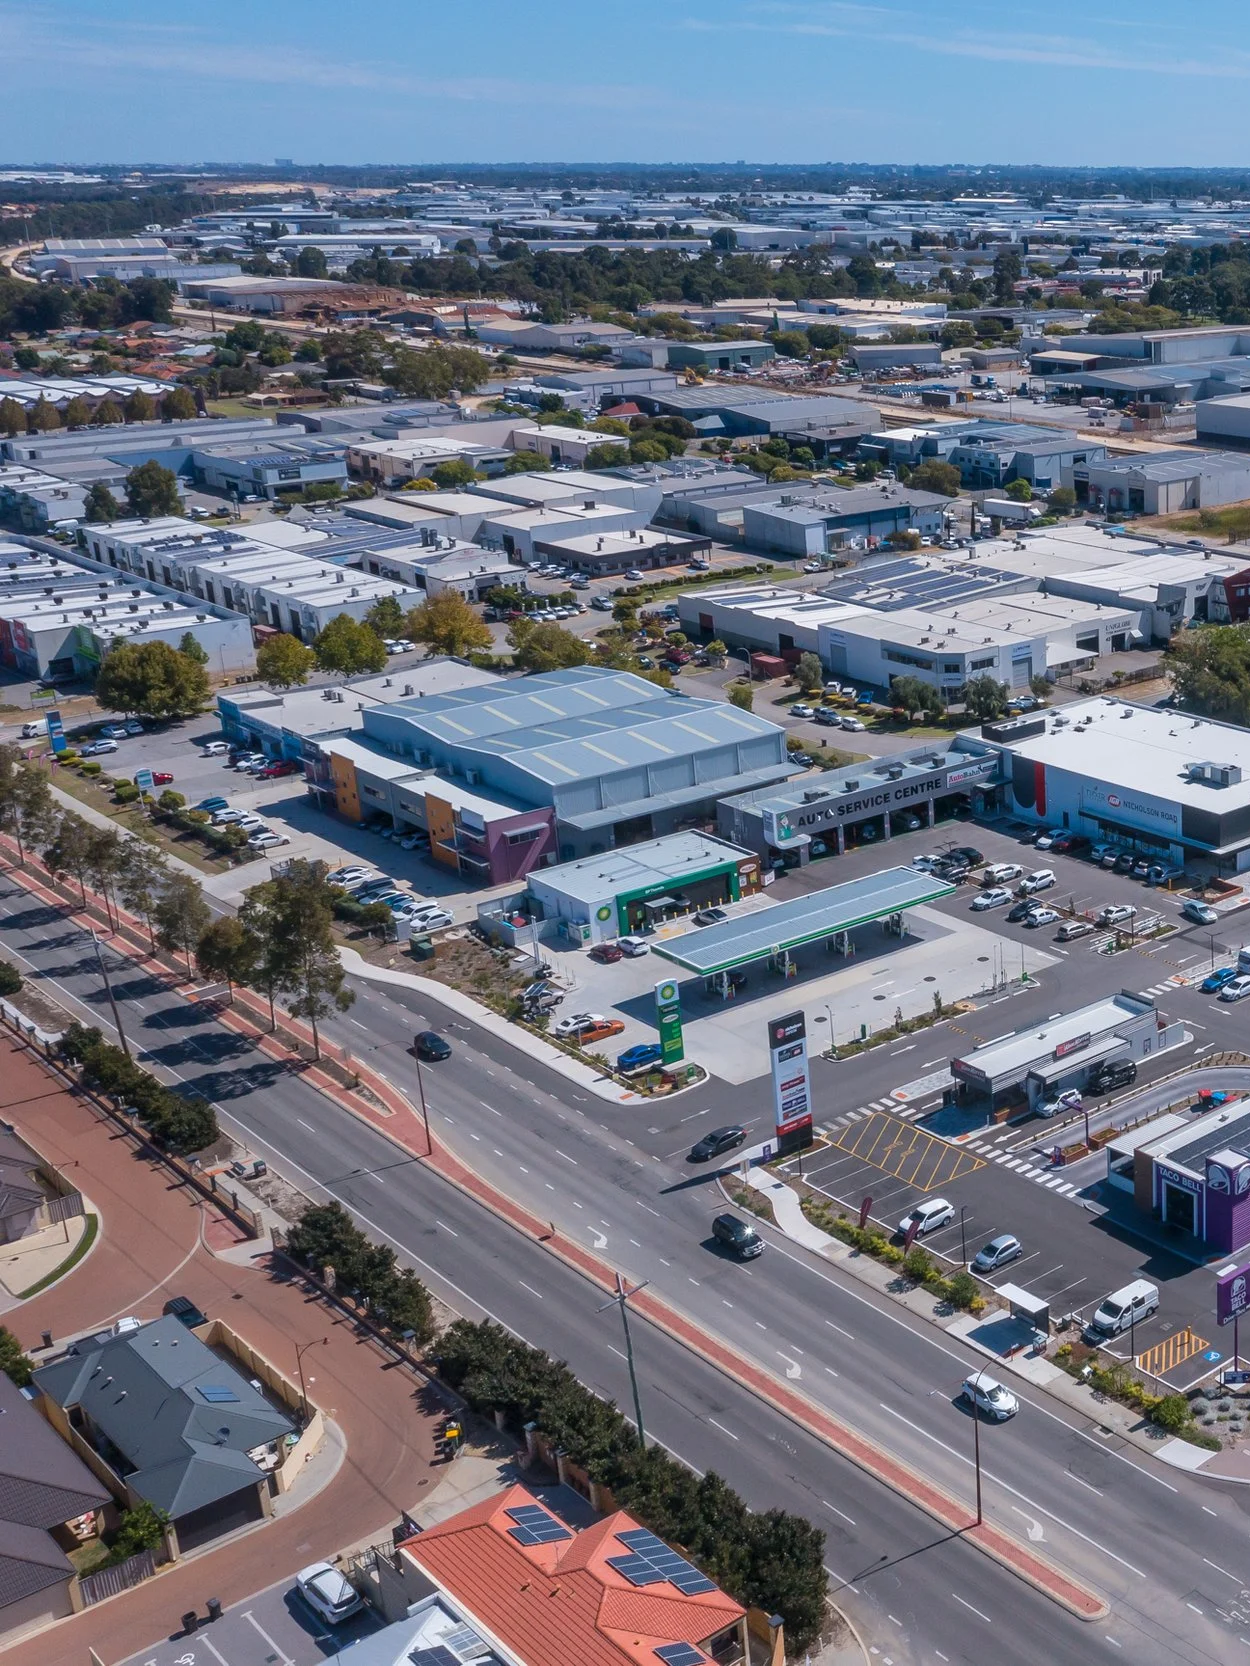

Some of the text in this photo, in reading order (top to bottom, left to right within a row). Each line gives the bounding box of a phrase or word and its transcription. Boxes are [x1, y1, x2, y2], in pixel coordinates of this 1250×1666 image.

[797, 808, 835, 828] AUTO
[836, 792, 891, 817] SERVICE
[894, 778, 942, 801] CENTRE
[1123, 800, 1178, 824] NICHOLSON ROAD
[1158, 1166, 1202, 1193] TACO BELL
[1230, 1291, 1247, 1304] TACO
[1231, 1299, 1246, 1311] BELL
